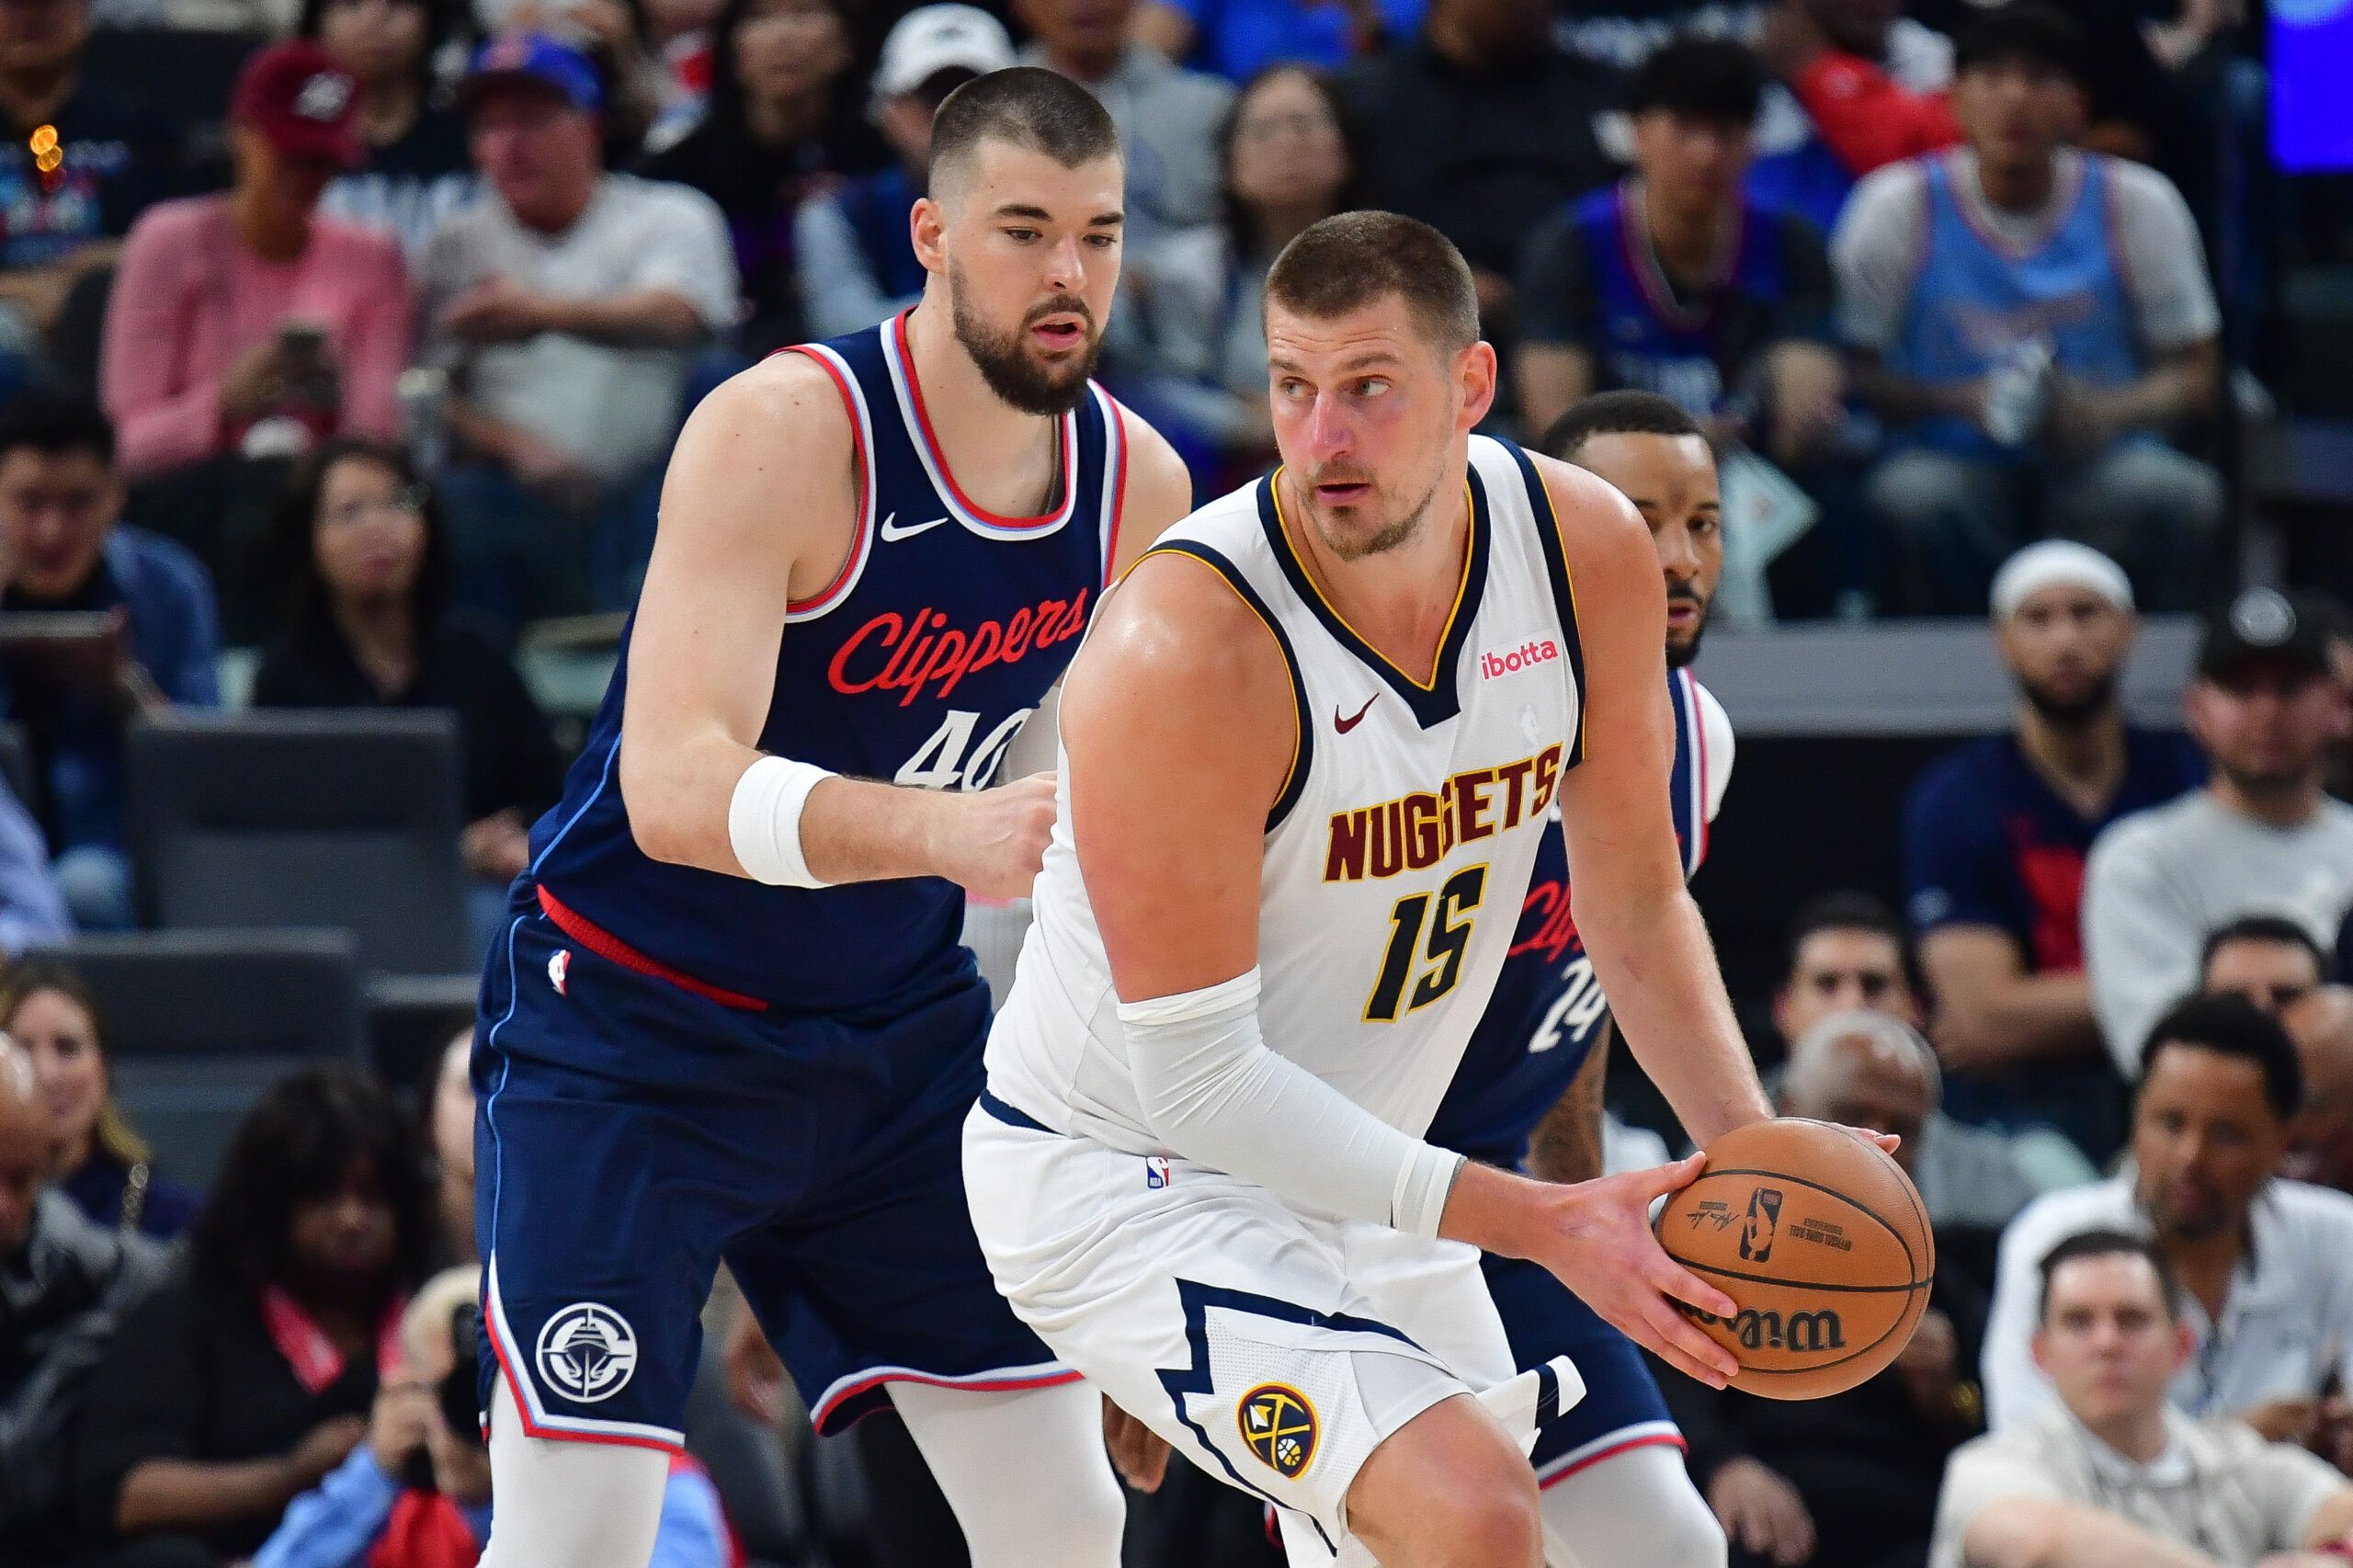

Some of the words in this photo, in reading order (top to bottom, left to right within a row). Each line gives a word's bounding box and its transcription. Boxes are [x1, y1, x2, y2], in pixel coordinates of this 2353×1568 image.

[827, 586, 1088, 707] Clippers
[1481, 641, 1558, 680] ibotta
[893, 708, 1032, 792] 40
[1361, 862, 1490, 1023] 15
[1528, 956, 1607, 1053] 24
